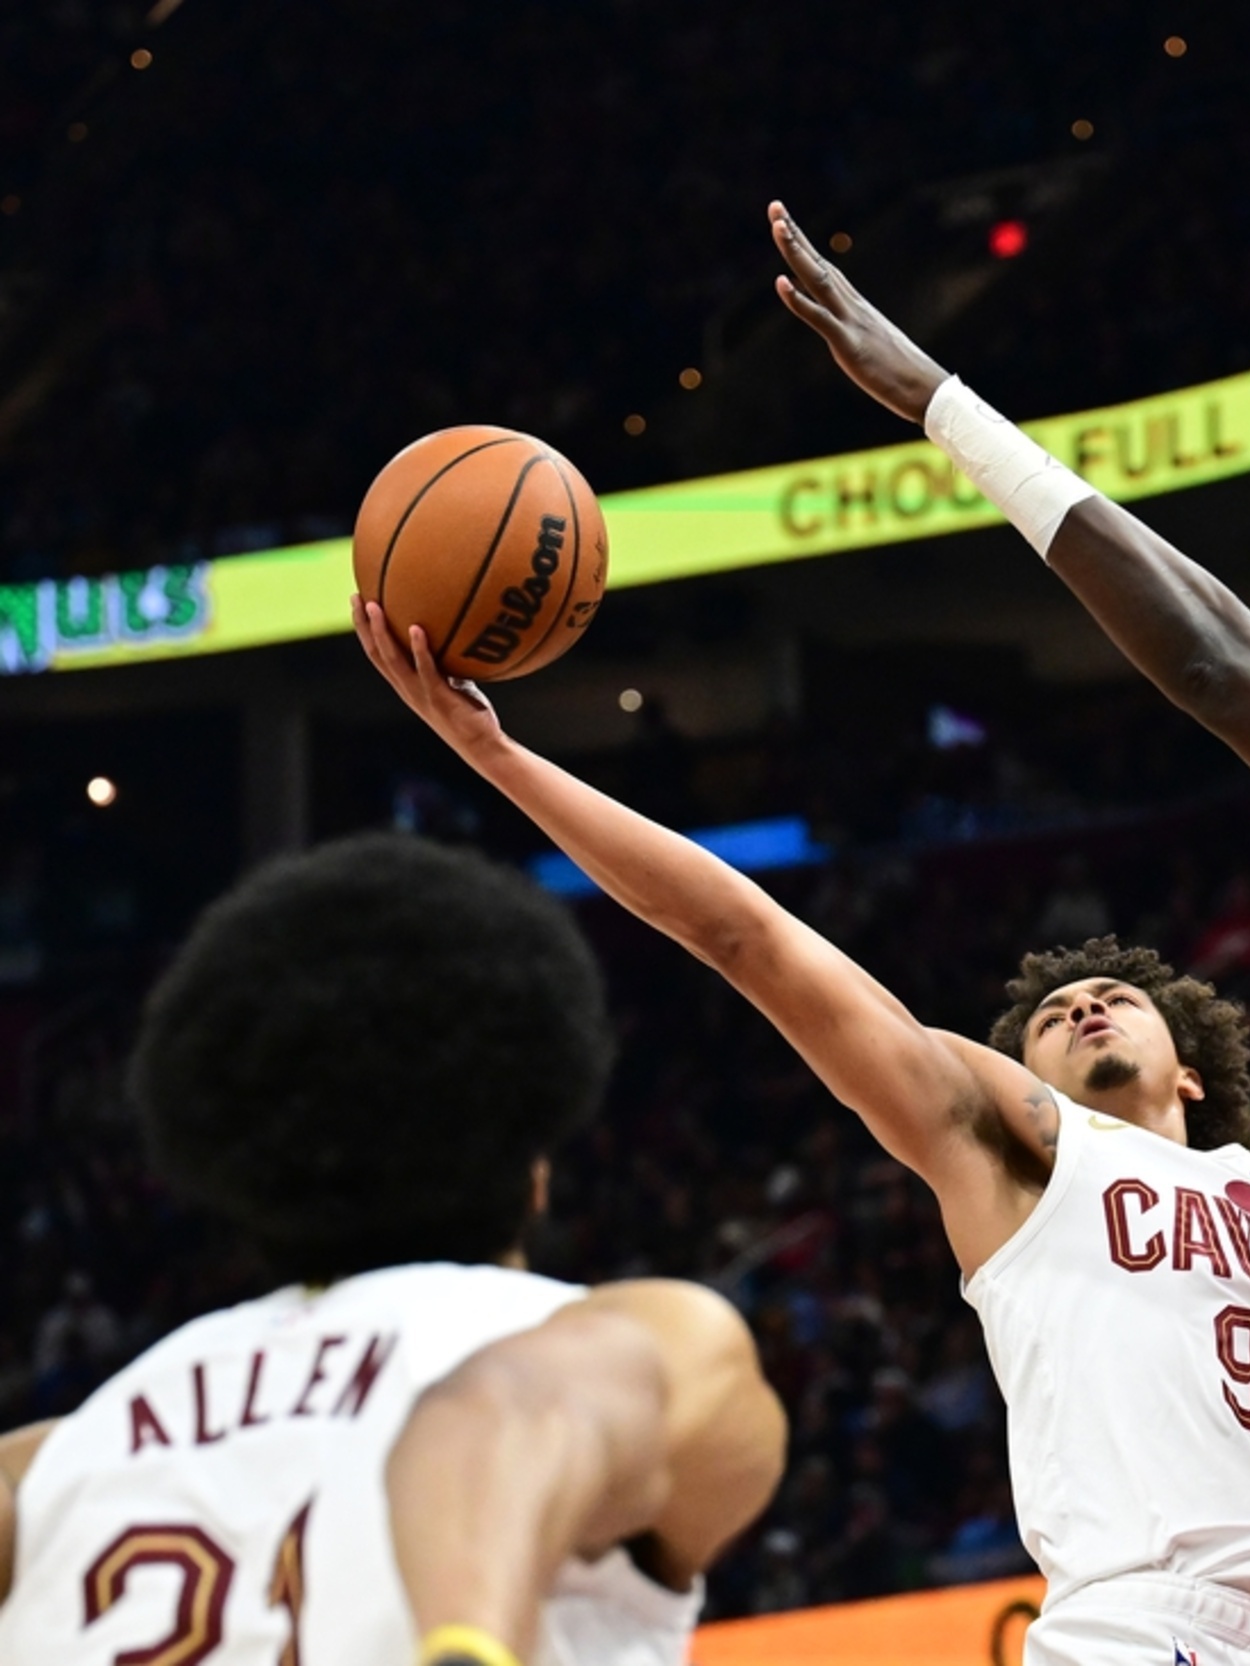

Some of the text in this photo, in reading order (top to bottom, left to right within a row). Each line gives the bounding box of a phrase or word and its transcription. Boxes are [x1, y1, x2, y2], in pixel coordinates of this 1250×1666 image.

[779, 457, 992, 539] CHOC
[1076, 402, 1242, 479] FULL
[461, 513, 567, 664] Wilson
[128, 1330, 400, 1455] ALLEN
